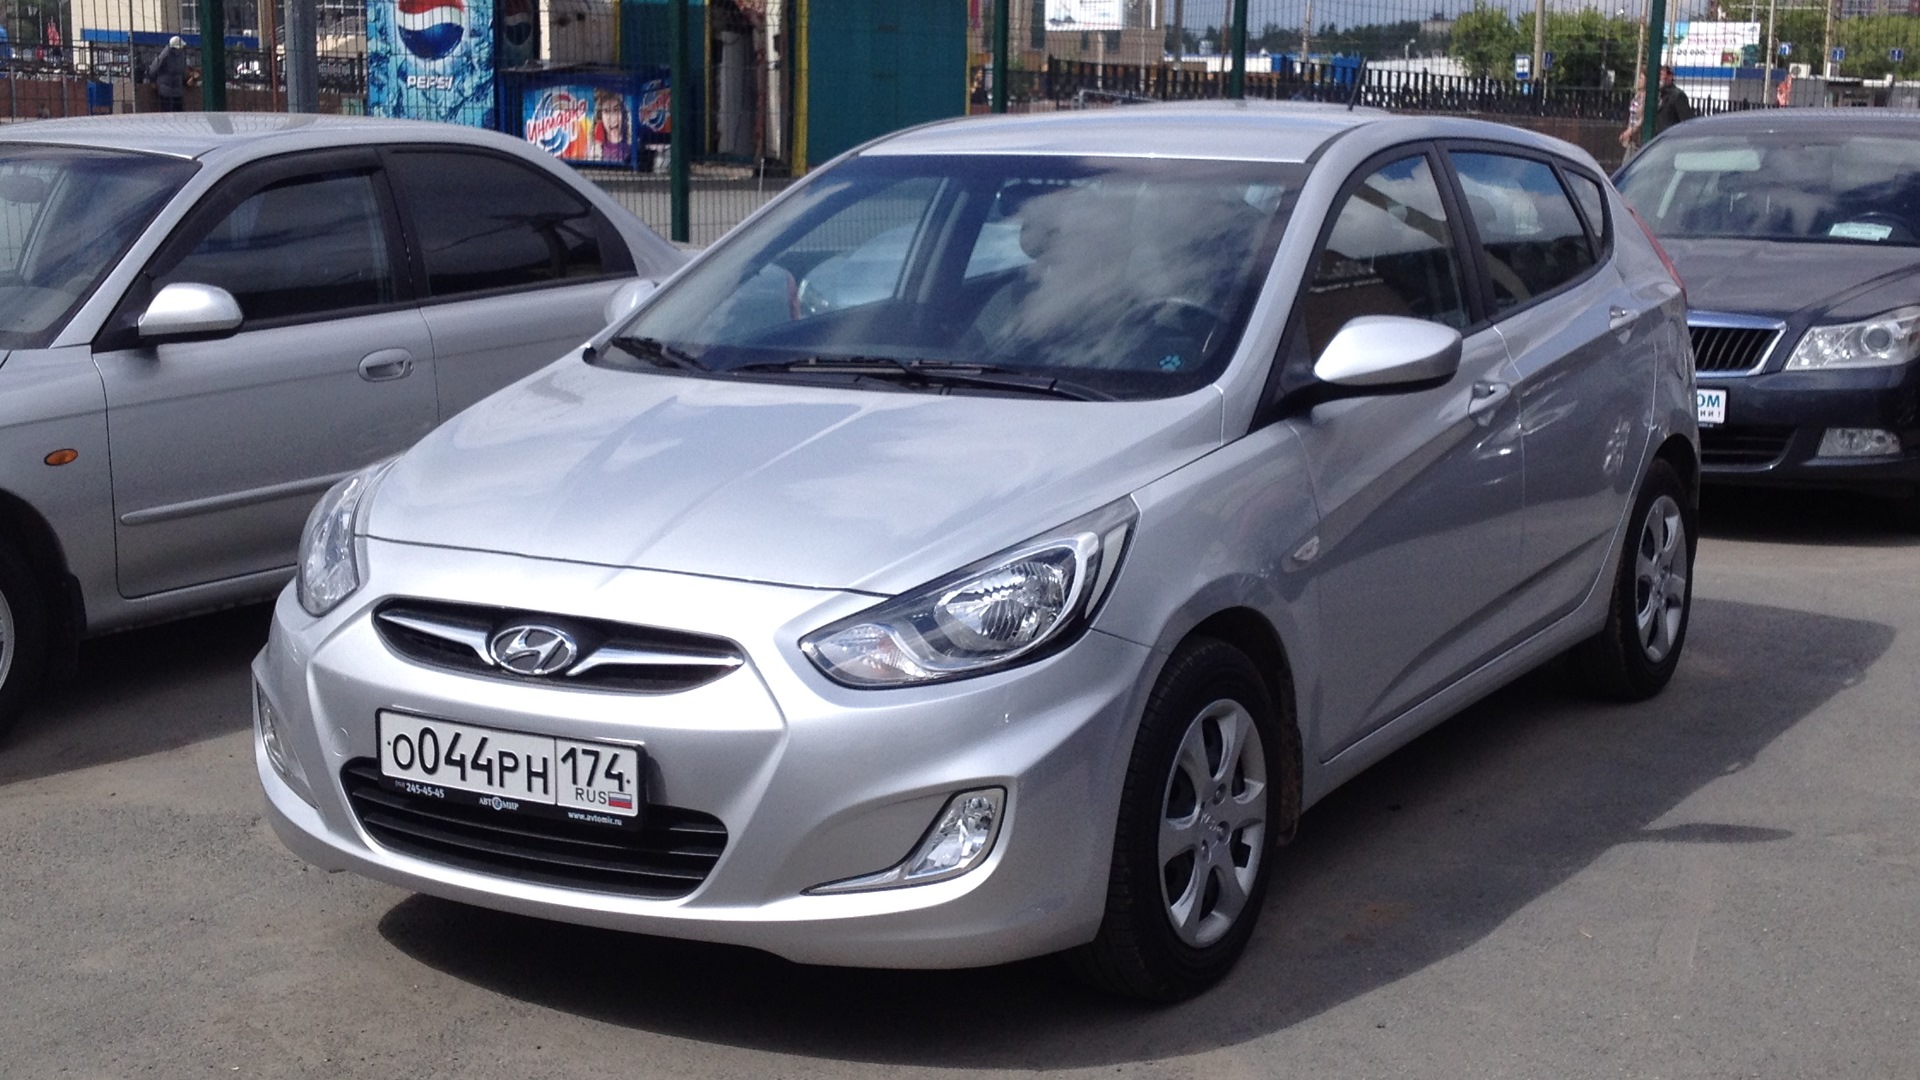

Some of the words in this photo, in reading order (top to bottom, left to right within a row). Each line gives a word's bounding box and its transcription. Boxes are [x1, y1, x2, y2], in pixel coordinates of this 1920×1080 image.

[406, 75, 454, 90] PEPSI
[392, 726, 549, 795] О044РН
[560, 747, 624, 792] 174
[405, 782, 445, 799] 245-45-45
[575, 787, 607, 805] RUS
